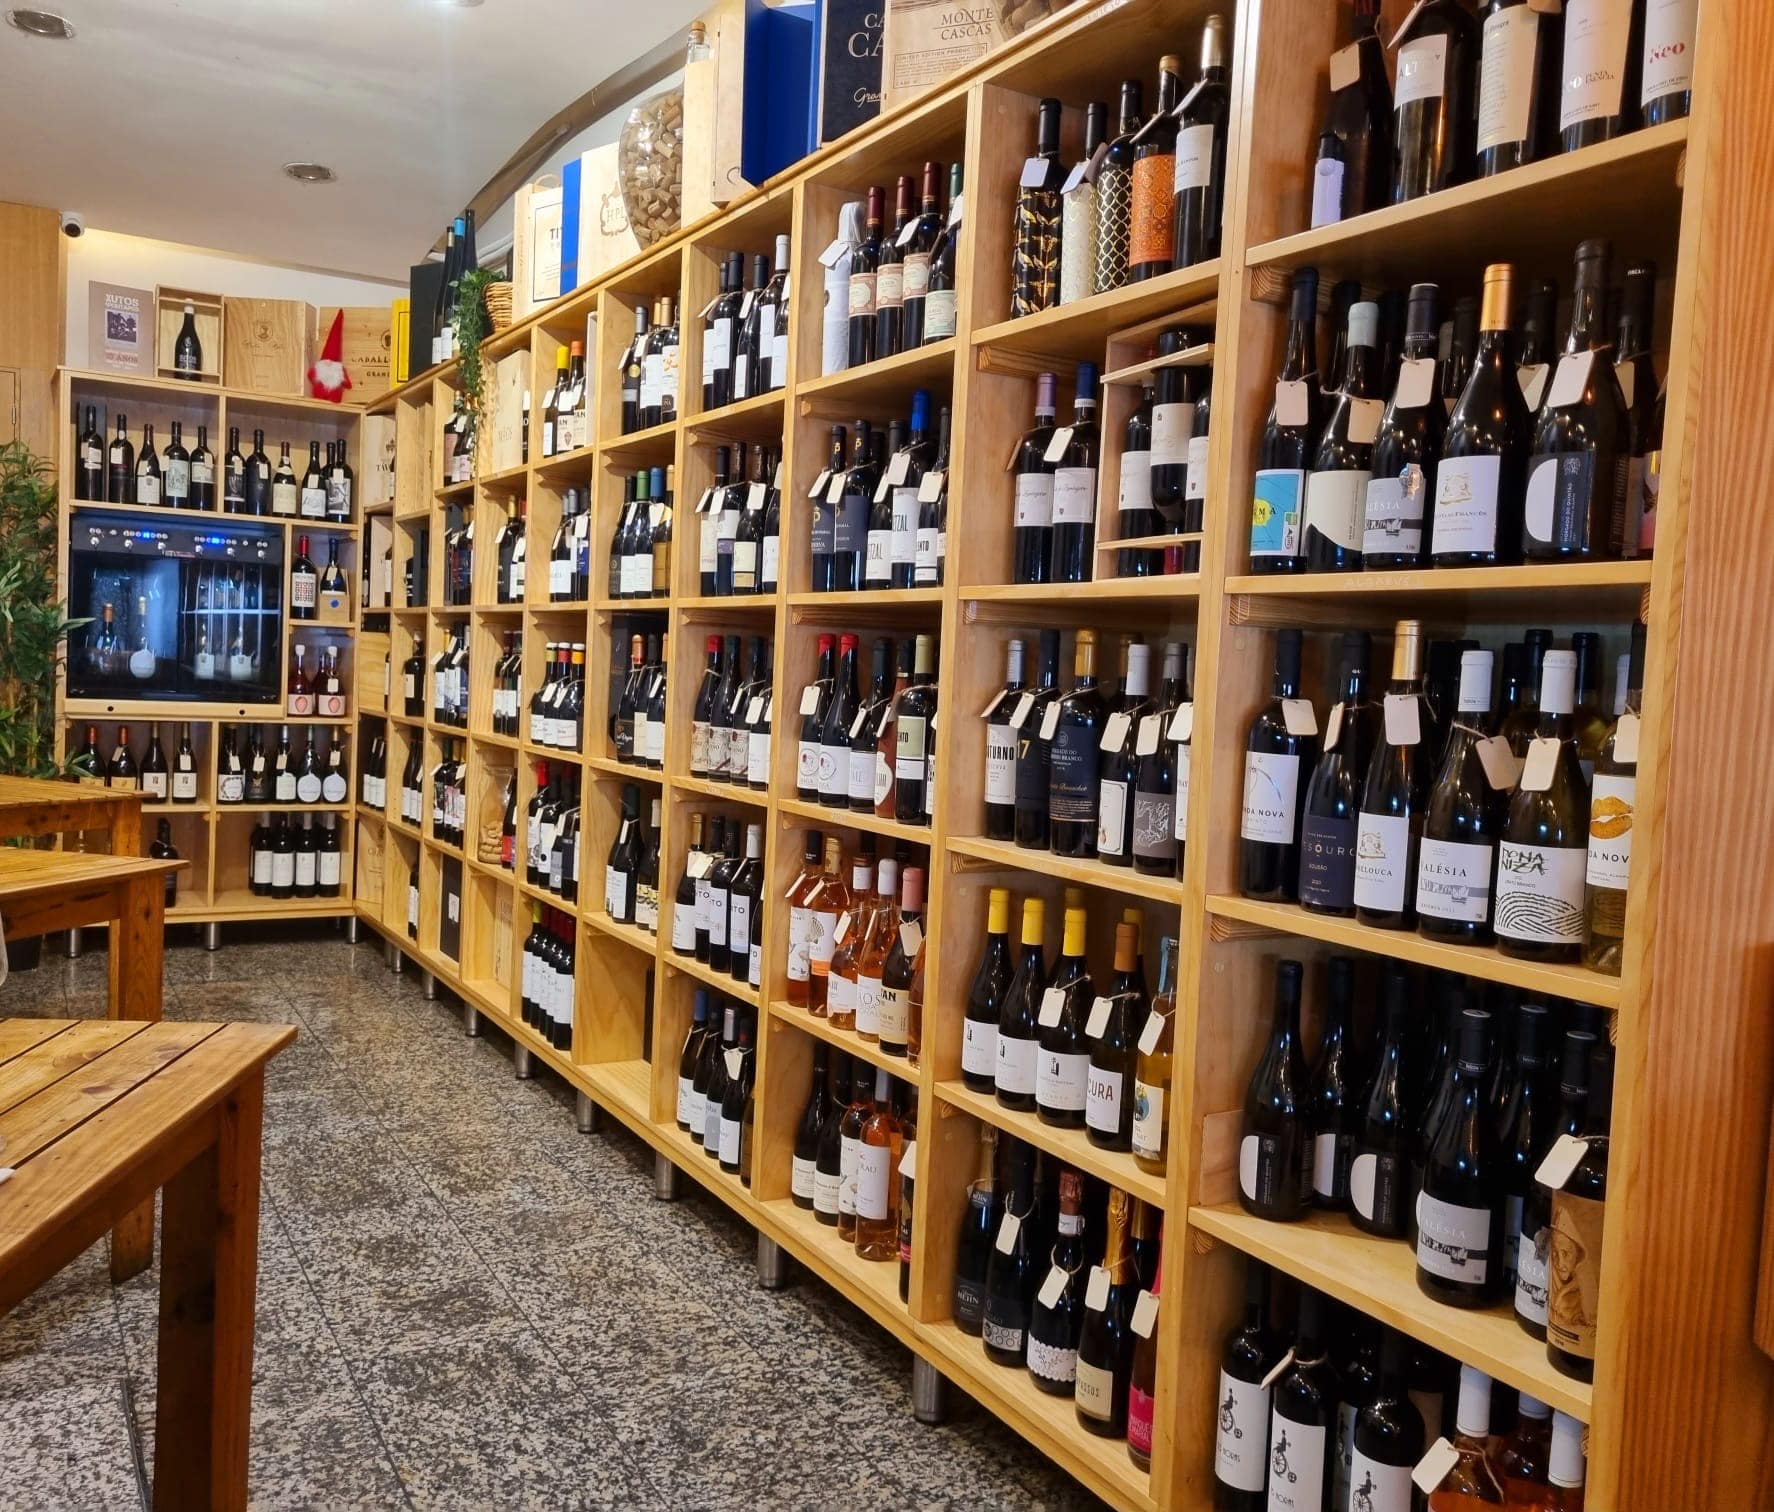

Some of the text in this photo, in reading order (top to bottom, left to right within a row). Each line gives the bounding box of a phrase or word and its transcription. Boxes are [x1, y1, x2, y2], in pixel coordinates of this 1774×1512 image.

[940, 7, 994, 26] MONTE
[941, 23, 992, 41] CASCAS
[1258, 809, 1285, 819] NOVA
[1424, 862, 1467, 878] ALÉSIA
